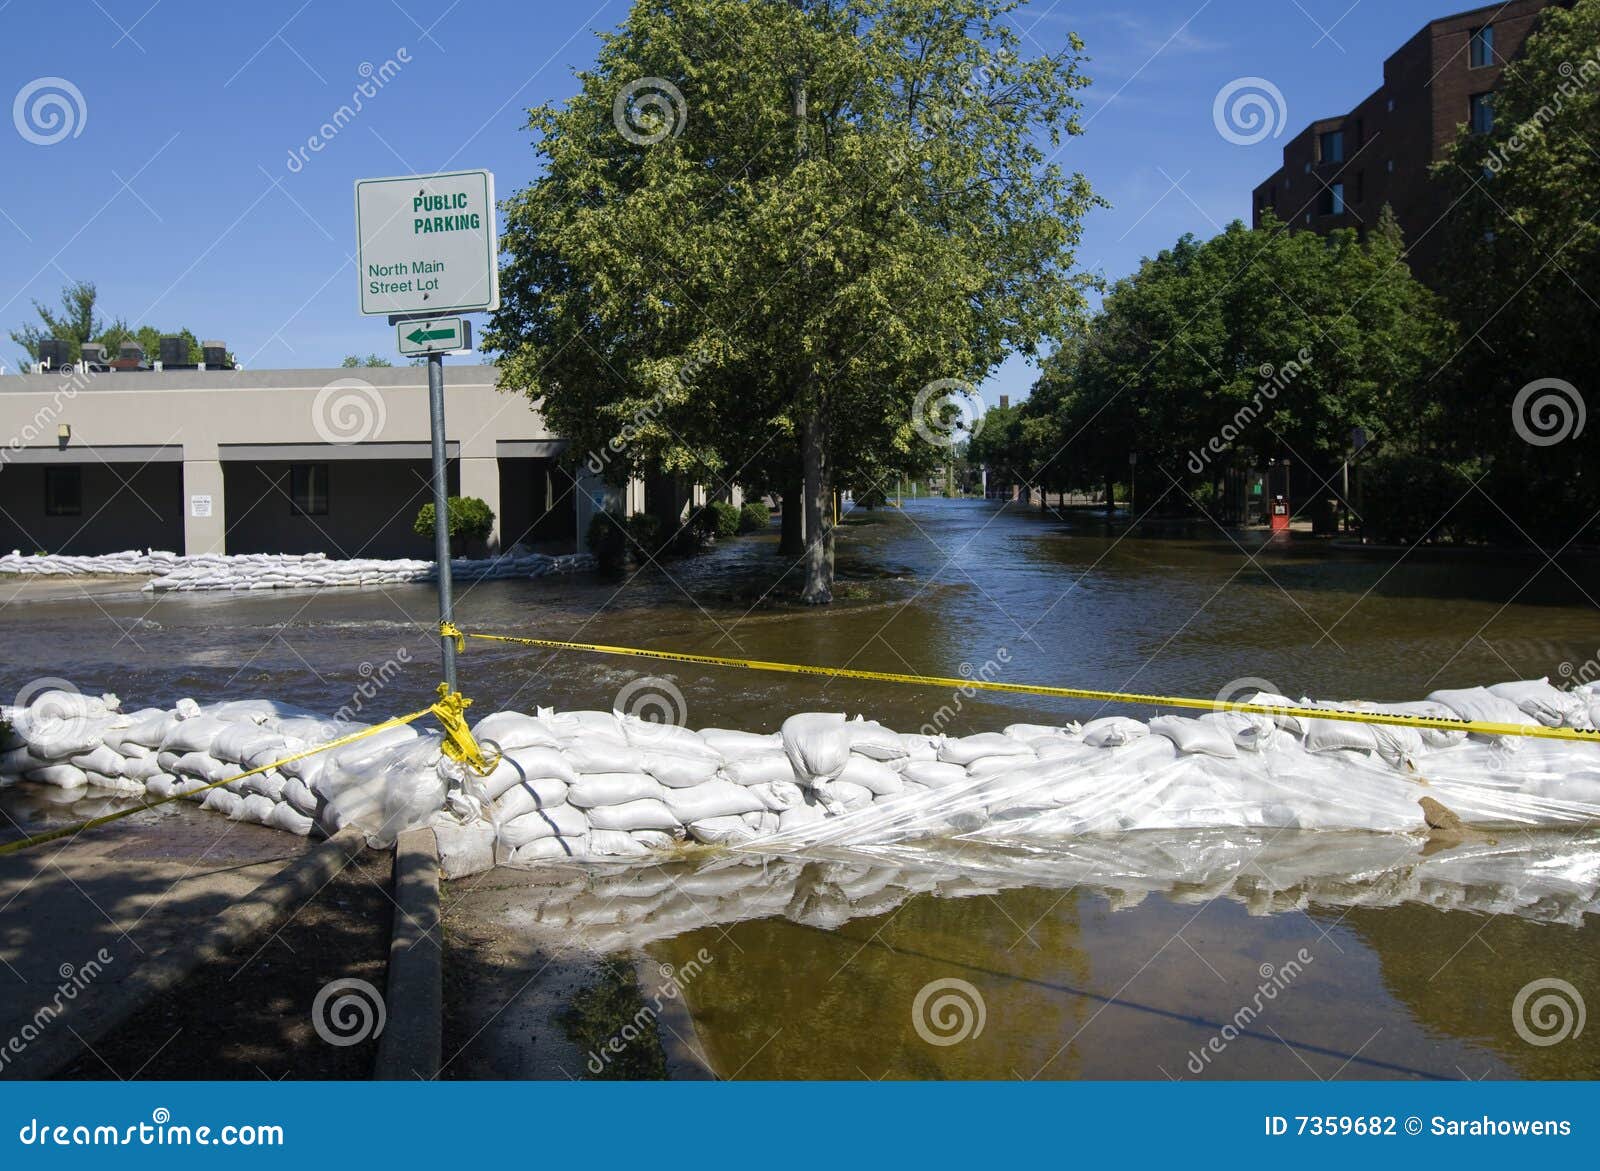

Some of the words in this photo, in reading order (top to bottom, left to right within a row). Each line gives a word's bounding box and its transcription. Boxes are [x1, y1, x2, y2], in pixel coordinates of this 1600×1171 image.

[413, 192, 468, 212] PUBLIC
[414, 213, 480, 234] PARKING
[369, 263, 408, 277] North
[412, 260, 445, 274] Main
[369, 280, 412, 294] Street
[417, 278, 439, 291] Lot
